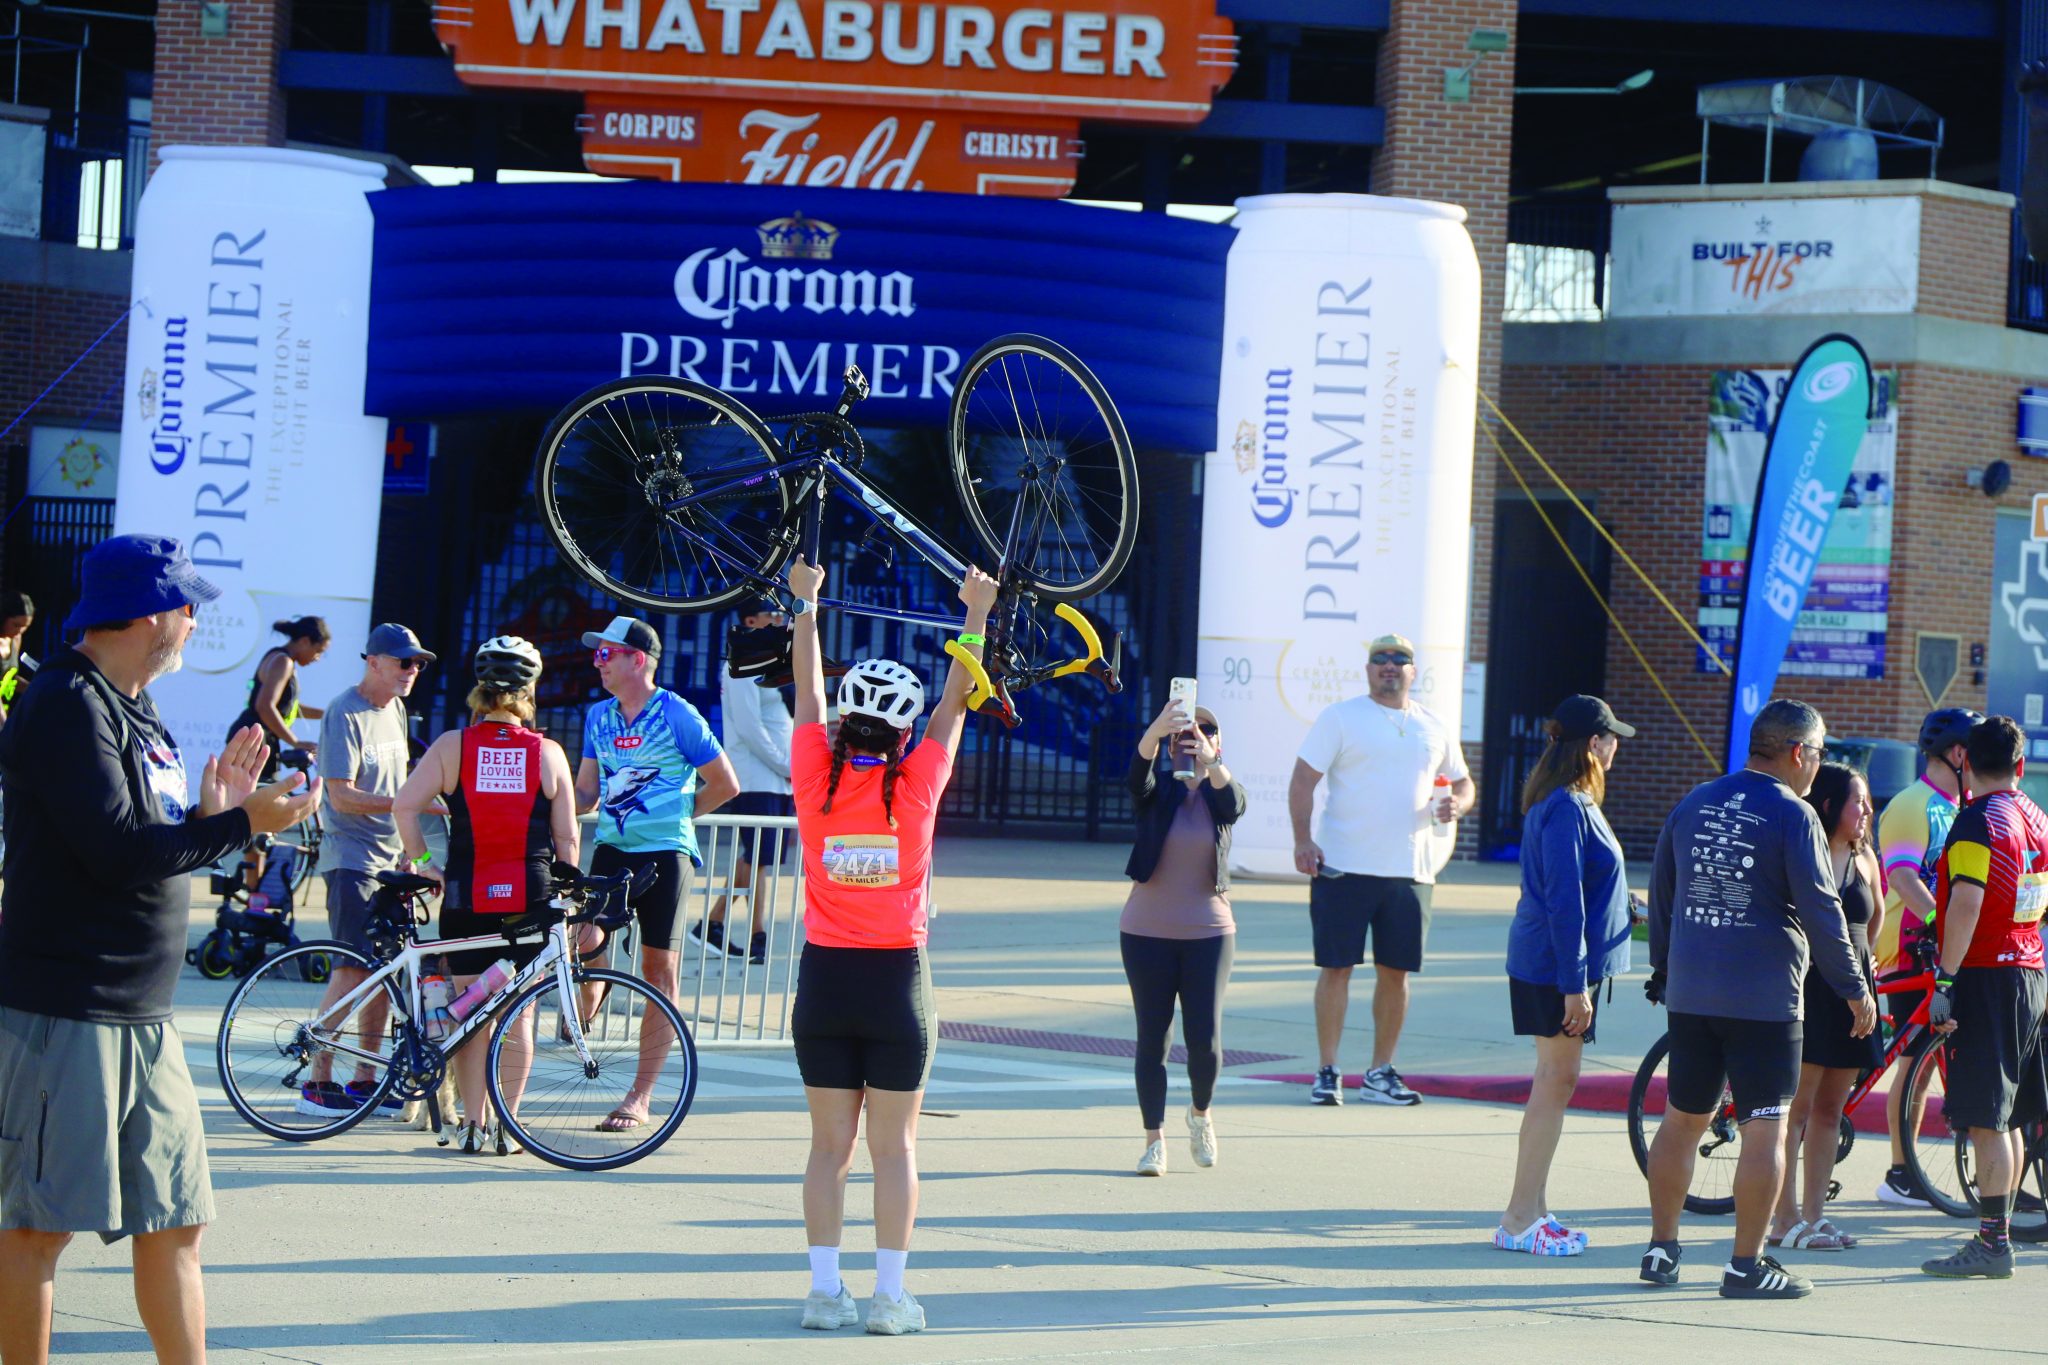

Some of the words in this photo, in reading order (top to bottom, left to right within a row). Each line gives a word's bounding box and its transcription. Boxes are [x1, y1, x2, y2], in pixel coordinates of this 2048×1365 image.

[509, 0, 1167, 78] WHATABURGER
[603, 112, 696, 140] CORPUS
[739, 108, 936, 191] Field
[964, 131, 1059, 160] CHRISTI
[1692, 241, 1768, 261] BUILT
[1778, 241, 1834, 259] FOR
[1723, 246, 1804, 301] THIS
[674, 247, 917, 329] Corona
[269, 299, 293, 454] EXCEPTIONAL
[295, 338, 311, 390] BEER
[620, 332, 961, 399] PREMIER
[150, 316, 192, 475] Corona
[190, 228, 266, 570] PREMIER
[1401, 387, 1417, 439] BEER
[290, 401, 308, 467] LIGHT
[1251, 367, 1299, 528] Corona
[1303, 276, 1372, 623] PREMIER
[265, 464, 282, 505] THE
[1768, 477, 1837, 621] BEER
[196, 613, 246, 628] RVEZA
[1222, 656, 1252, 686] 90
[481, 751, 523, 765] BEEF
[481, 766, 523, 777] LOVING
[832, 853, 889, 875] 2471
